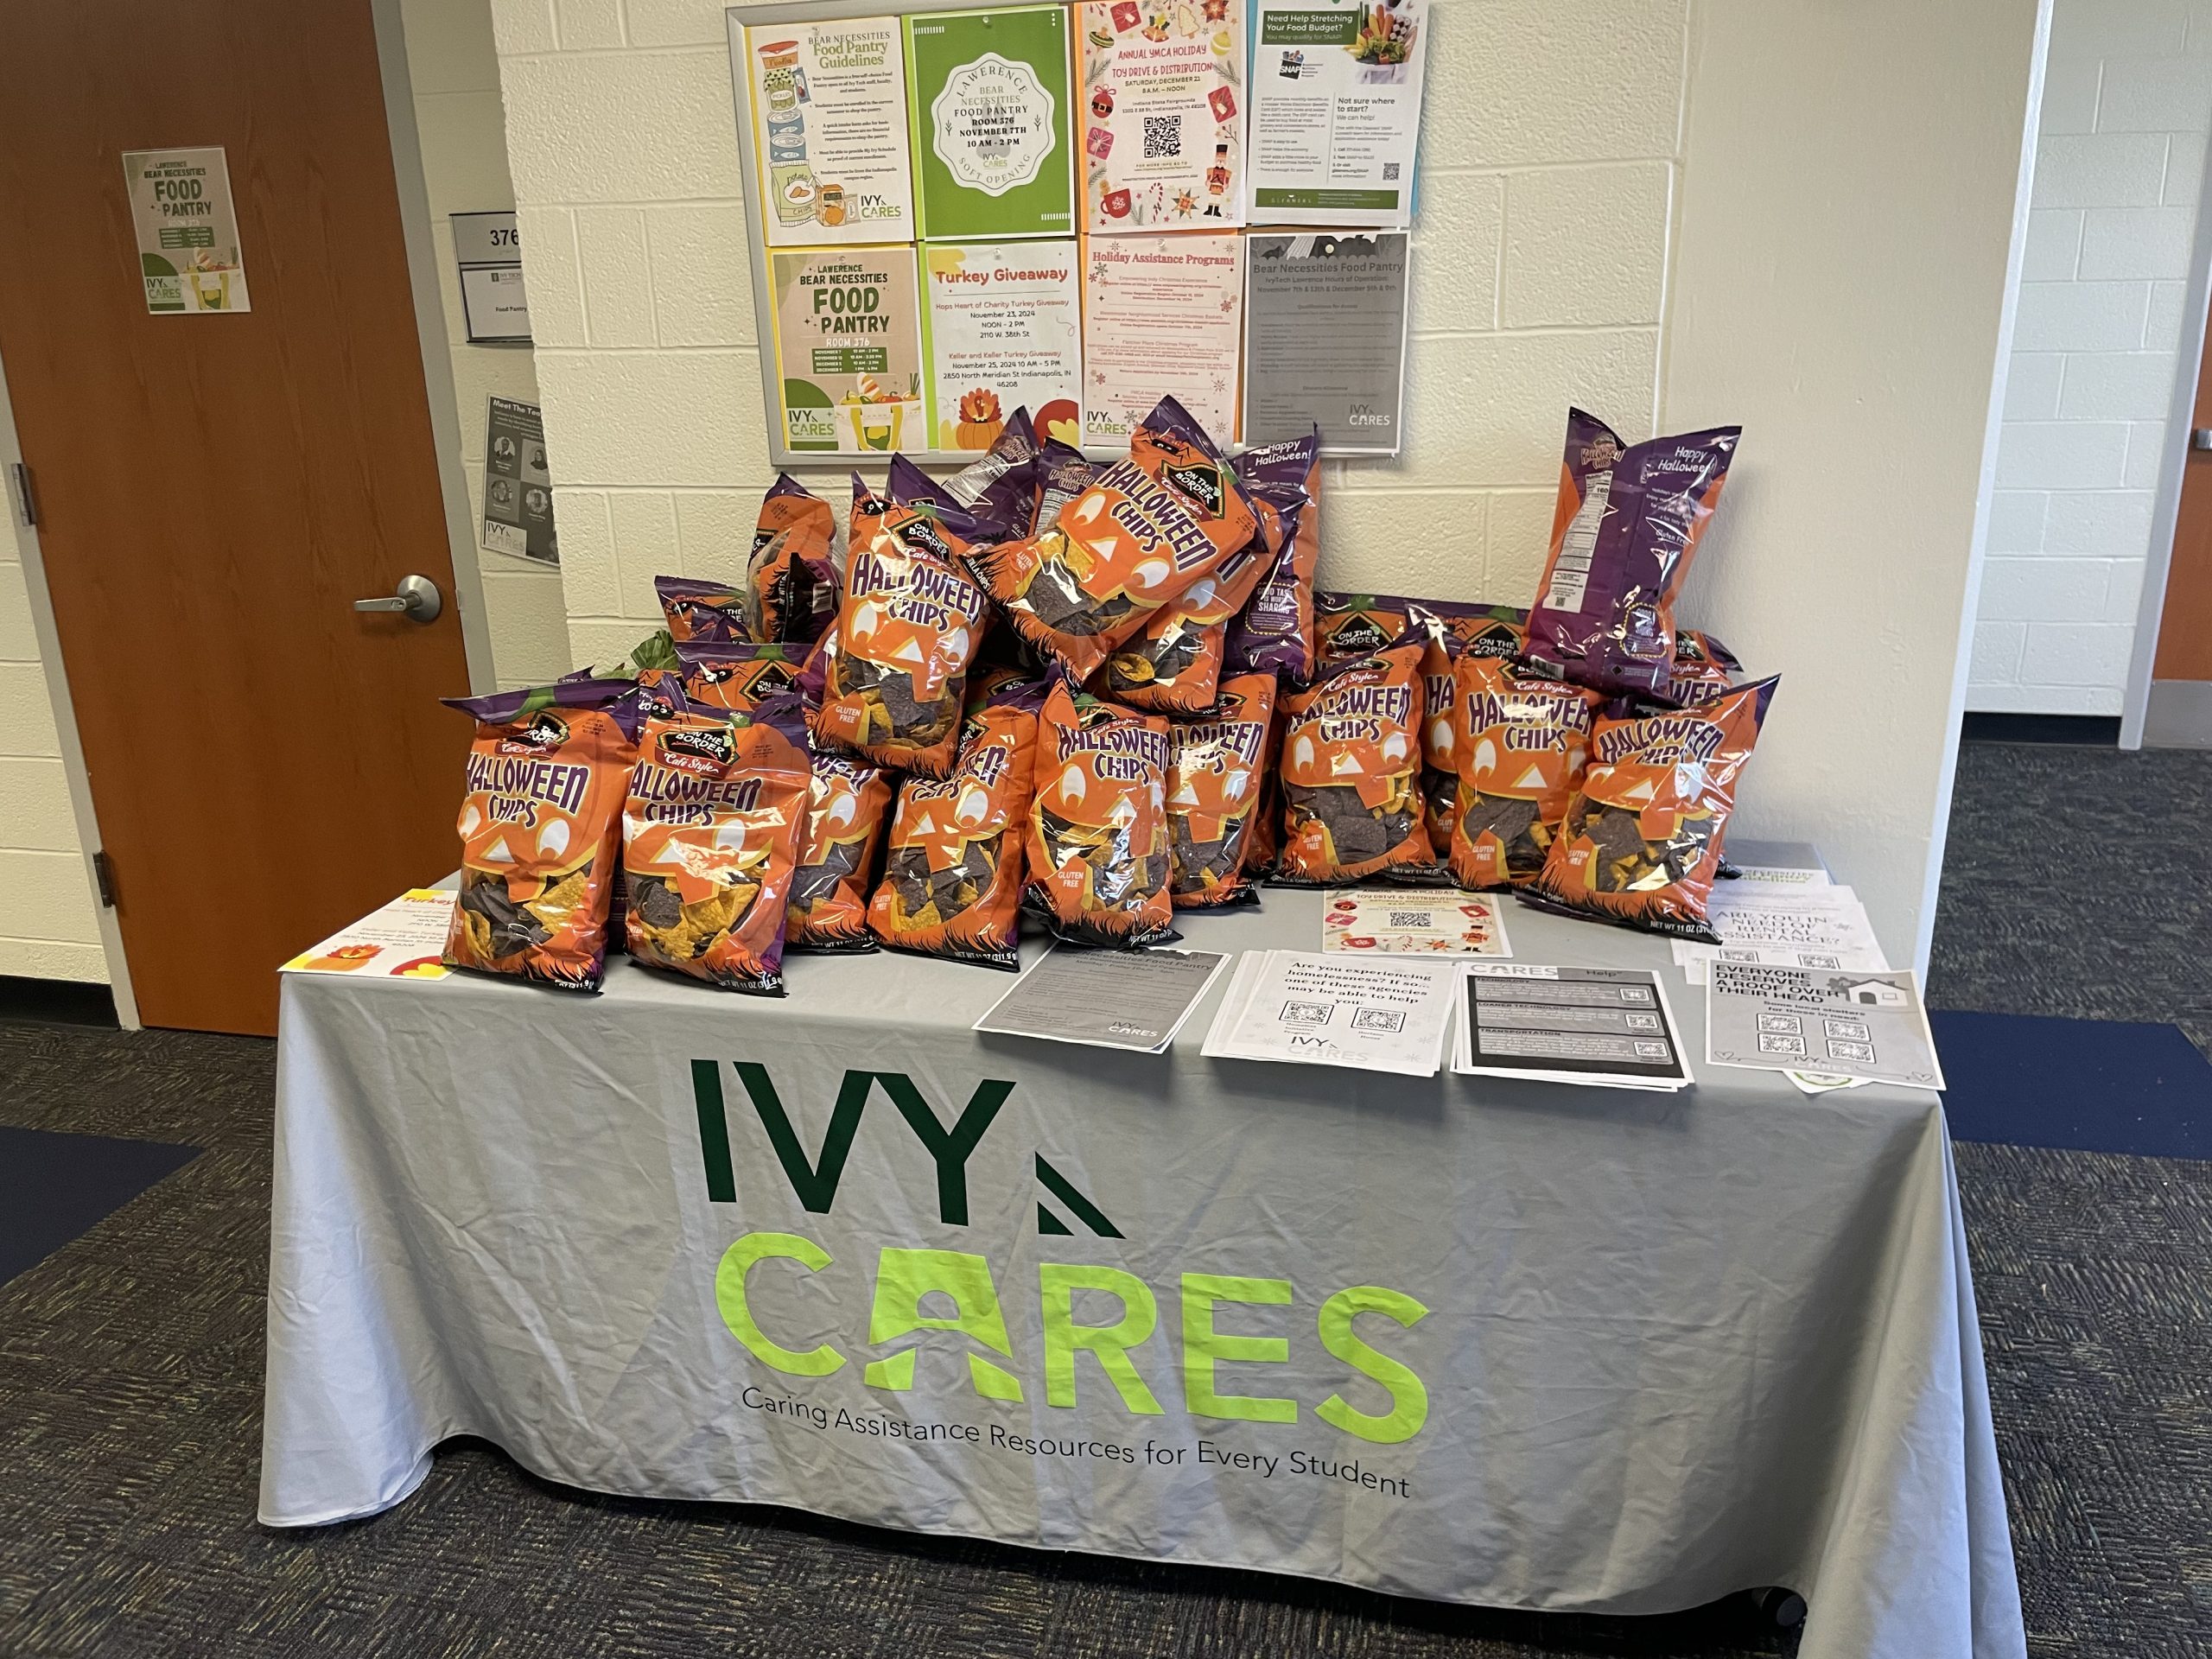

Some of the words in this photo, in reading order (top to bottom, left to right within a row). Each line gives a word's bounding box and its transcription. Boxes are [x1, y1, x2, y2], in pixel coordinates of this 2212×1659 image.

[1291, 15, 1309, 23] Help
[1311, 15, 1353, 24] Stretching
[1309, 24, 1343, 34] Budget?
[809, 36, 831, 45] BEAR
[833, 32, 891, 43] NECESSITIES
[813, 43, 843, 56] Food
[846, 41, 888, 55] Pantry
[1118, 48, 1148, 60] ANNUAL
[1149, 47, 1172, 59] YMCA
[1173, 45, 1207, 56] HOLIDAY
[819, 54, 885, 69] Guidelines
[1113, 68, 1128, 79] TOY
[1128, 67, 1150, 77] DRIVE
[1160, 62, 1213, 75] DISTRIBUTION
[957, 66, 1028, 98] LAWERENCE
[980, 86, 1004, 95] BEAR
[961, 95, 1020, 106] NECESSITIES
[955, 109, 982, 118] FOOD
[987, 105, 1028, 115] PANTRY
[960, 129, 1007, 137] NOVEMBER
[960, 157, 982, 181] SOFT
[987, 154, 1031, 184] OPENING
[983, 160, 1008, 168] CARES
[155, 179, 202, 202] FOOD
[861, 195, 882, 207] IVY
[162, 201, 213, 217] PANTRY
[861, 207, 902, 219] CARES
[490, 229, 519, 245] 376
[1092, 251, 1131, 264] Holiday
[1131, 253, 1183, 264] Assistance
[1185, 254, 1235, 267] Programs
[817, 264, 863, 274] LAWERENCE
[1253, 264, 1278, 274] Bear
[1280, 262, 1338, 273] Necessities
[1340, 262, 1367, 271] Food
[1369, 261, 1404, 274] Pantry
[147, 277, 163, 289] IVY
[800, 276, 826, 286] BEAR
[830, 273, 889, 285] NECESSITIES
[936, 269, 990, 287] Turkey
[994, 267, 1069, 283] Giveaway
[149, 289, 181, 300] CARES
[814, 287, 880, 315] FOOD
[983, 301, 1010, 309] Charity
[1011, 300, 1035, 309] Turkey
[1036, 299, 1070, 308] Giveaway
[969, 311, 1004, 320] November
[822, 315, 890, 334] PANTRY
[827, 338, 851, 348] ROOM
[1004, 351, 1028, 359] Turkey
[1029, 350, 1062, 359] Giveaway
[982, 370, 1012, 378] Meridian
[1021, 369, 1063, 378] Indianapolis,
[493, 399, 511, 410] Meet
[512, 404, 526, 414] The
[1350, 404, 1370, 415] IVY
[788, 410, 813, 423] IVY
[1087, 410, 1109, 423] IVY
[1350, 415, 1390, 426] CARES
[790, 423, 835, 436] CARES
[1087, 423, 1128, 435] CARES
[1268, 441, 1301, 454] Happy
[1675, 446, 1708, 464] Happy
[1255, 448, 1312, 467] Halloween!
[1185, 470, 1199, 483] ON
[1198, 477, 1214, 493] THE
[1175, 473, 1213, 507] BORDER
[1096, 459, 1217, 573] HALLOWEEN
[1111, 501, 1165, 554] CHIPS
[908, 527, 949, 557] BORDER
[850, 552, 985, 626] HALLOWEEN
[887, 596, 950, 633] CHIPS
[1478, 638, 1495, 648] ON
[1496, 640, 1516, 652] THE
[1514, 681, 1540, 691] Café
[1541, 681, 1573, 695] Style
[836, 705, 862, 717] GLUTEN
[1287, 685, 1412, 736] HALLOWEEN
[839, 715, 856, 724] FREE
[1319, 718, 1382, 744] CHIPS
[676, 734, 726, 759] BORDER
[1054, 721, 1168, 773] HALLOWEEN
[1504, 726, 1567, 753] CHIPS
[1598, 717, 1725, 768] HALLOWEEN
[664, 753, 689, 768] Café
[688, 758, 720, 775] Style
[1094, 752, 1149, 785] CHIPS
[489, 795, 537, 828] CHIPS
[645, 803, 715, 827] CHIPS
[1472, 845, 1496, 854] GLUTEN
[1477, 852, 1491, 861] FREE
[1058, 871, 1084, 881] GLUTEN
[1063, 880, 1084, 888] FREE
[1650, 920, 1663, 929] NET
[1287, 969, 1386, 984] homelessness?
[1345, 968, 1432, 982] experiencing
[1471, 963, 1557, 977] CARES
[1716, 964, 1812, 981] EVERYONE
[1716, 972, 1811, 988] DESERVES
[1287, 986, 1316, 995] may
[1389, 995, 1419, 1005] help
[1370, 986, 1428, 996] agencies
[1716, 987, 1768, 997] THEIR
[1773, 992, 1824, 1004] HEAD
[1733, 981, 1785, 991] ROOF
[1789, 986, 1840, 998] OVER
[1109, 1026, 1159, 1037] CARES
[1480, 1028, 1561, 1037] TRANSPORTATION
[1287, 1045, 1369, 1063] CARES
[690, 1058, 1018, 1227] IVY
[715, 1231, 1431, 1445] CARES
[742, 1387, 829, 1432] Caring
[834, 1408, 983, 1446] Assistance
[989, 1423, 1137, 1464] Resources
[1141, 1440, 1188, 1465] for
[1196, 1441, 1280, 1479] Every
[1288, 1448, 1412, 1499] Student
